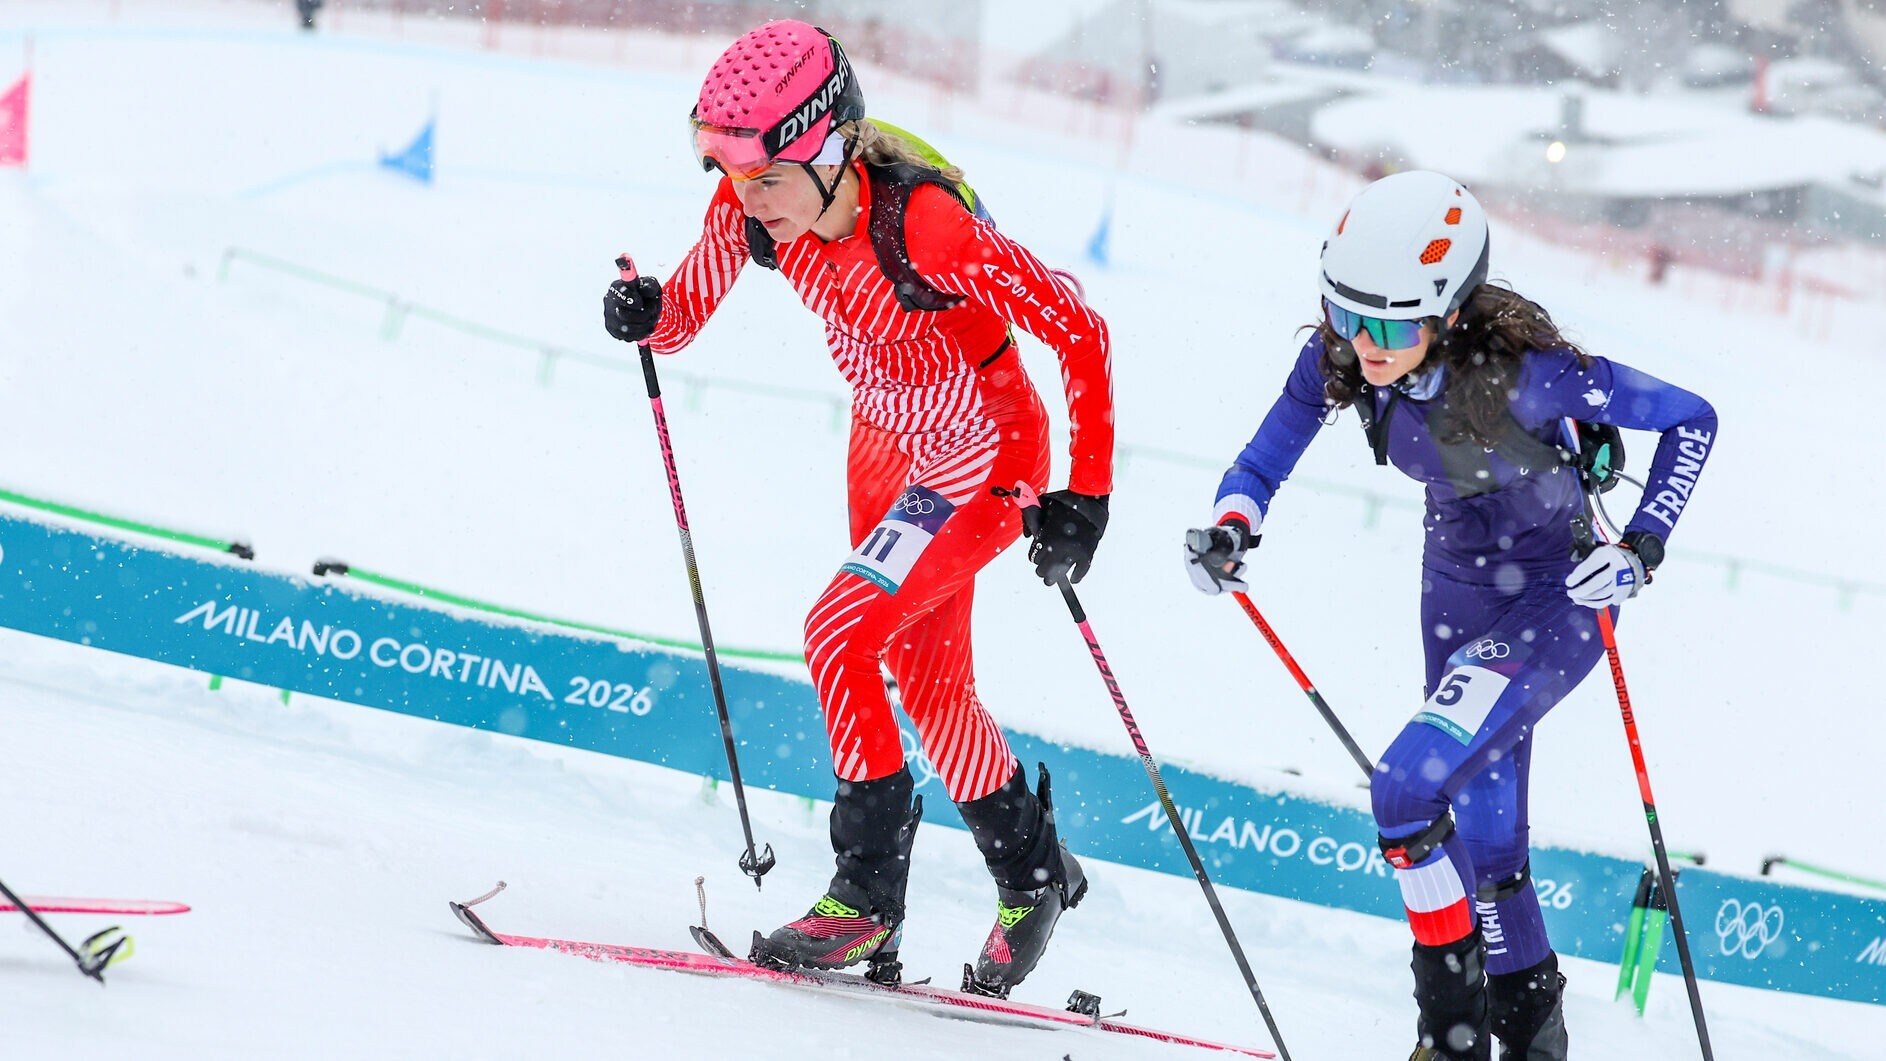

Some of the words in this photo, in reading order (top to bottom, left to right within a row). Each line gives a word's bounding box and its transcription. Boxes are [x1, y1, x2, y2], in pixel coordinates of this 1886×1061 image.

[775, 46, 815, 95] DYNAFIT
[982, 263, 1082, 344] AUSTRIA
[1643, 426, 1711, 529] FRANCE
[860, 527, 902, 563] 11
[174, 600, 362, 660] MILANO
[370, 637, 555, 701] CORTINA
[564, 676, 652, 716] 2026
[1435, 674, 1472, 706] 5
[1607, 647, 1635, 726] ROSSIGNOL
[1121, 800, 1301, 857] MILANO
[1307, 837, 1400, 880] COR
[1530, 877, 1573, 910] 26
